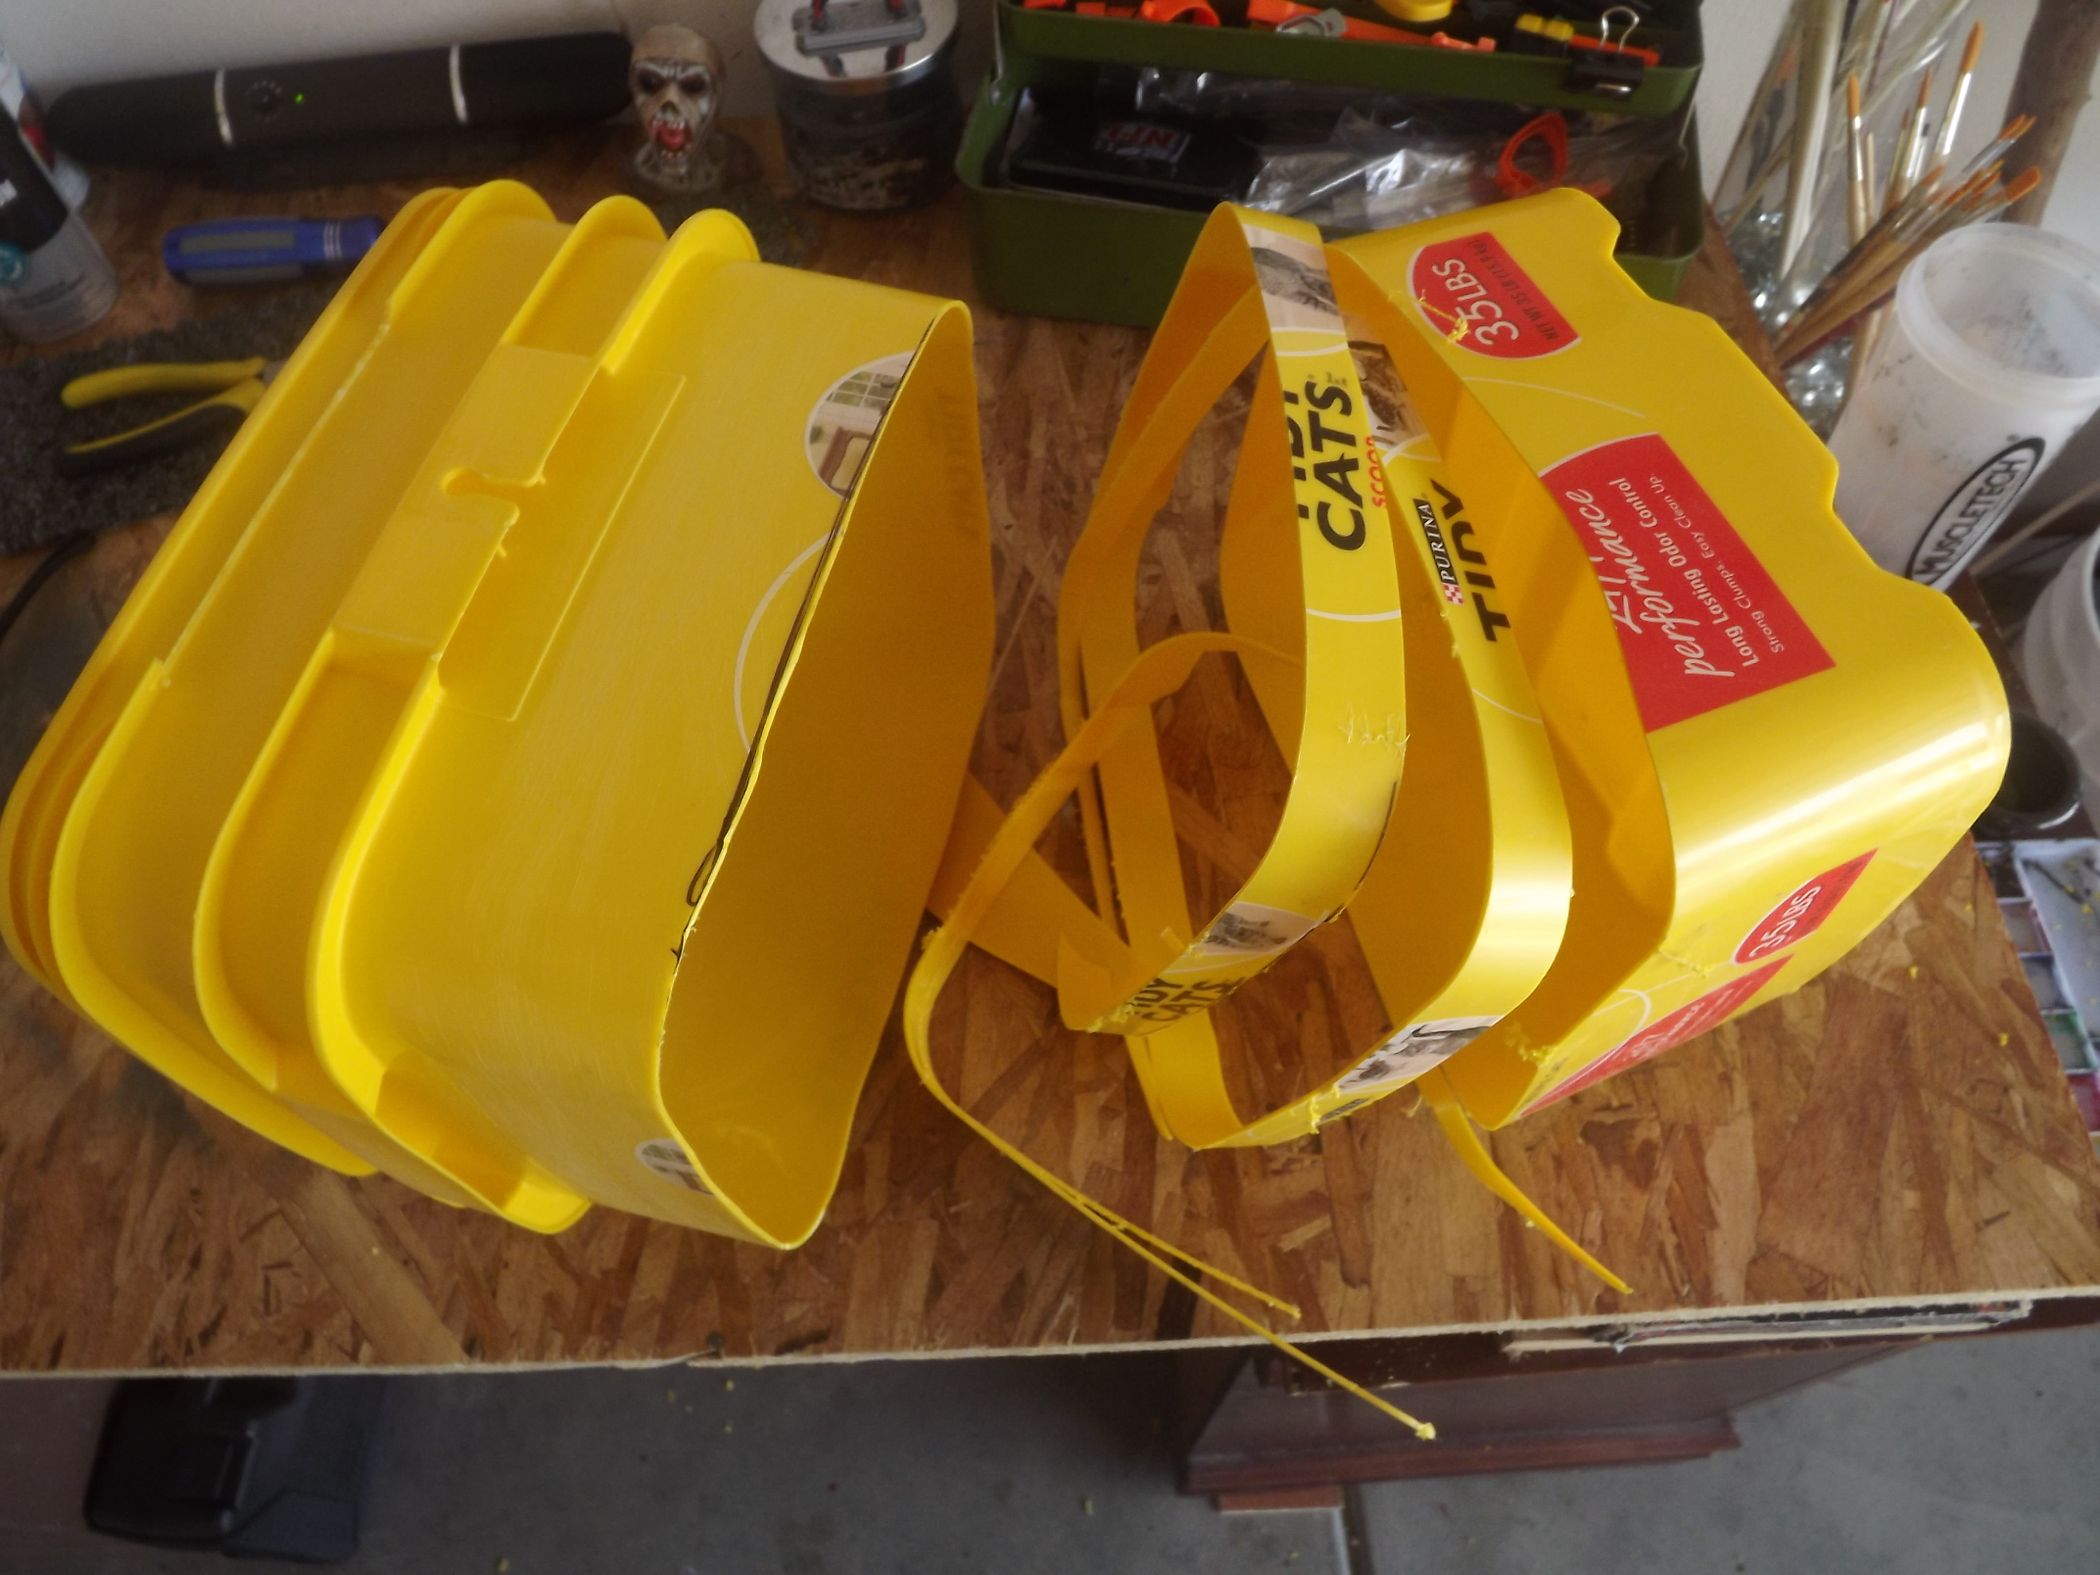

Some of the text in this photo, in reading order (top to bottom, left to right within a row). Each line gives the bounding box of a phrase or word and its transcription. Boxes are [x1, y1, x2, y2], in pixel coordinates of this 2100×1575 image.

[1304, 380, 1366, 551] CATS
[1417, 503, 1457, 583] PURINA
[1663, 494, 1692, 529] Clean
[1691, 530, 1716, 560] Easy
[1914, 458, 2027, 576] MUSCLETECH
[1565, 488, 1735, 677] performance
[1609, 477, 1760, 667] Long Lasting Odor Control
[1715, 560, 1751, 610] Clumps.
[1751, 610, 1784, 654] Strong
